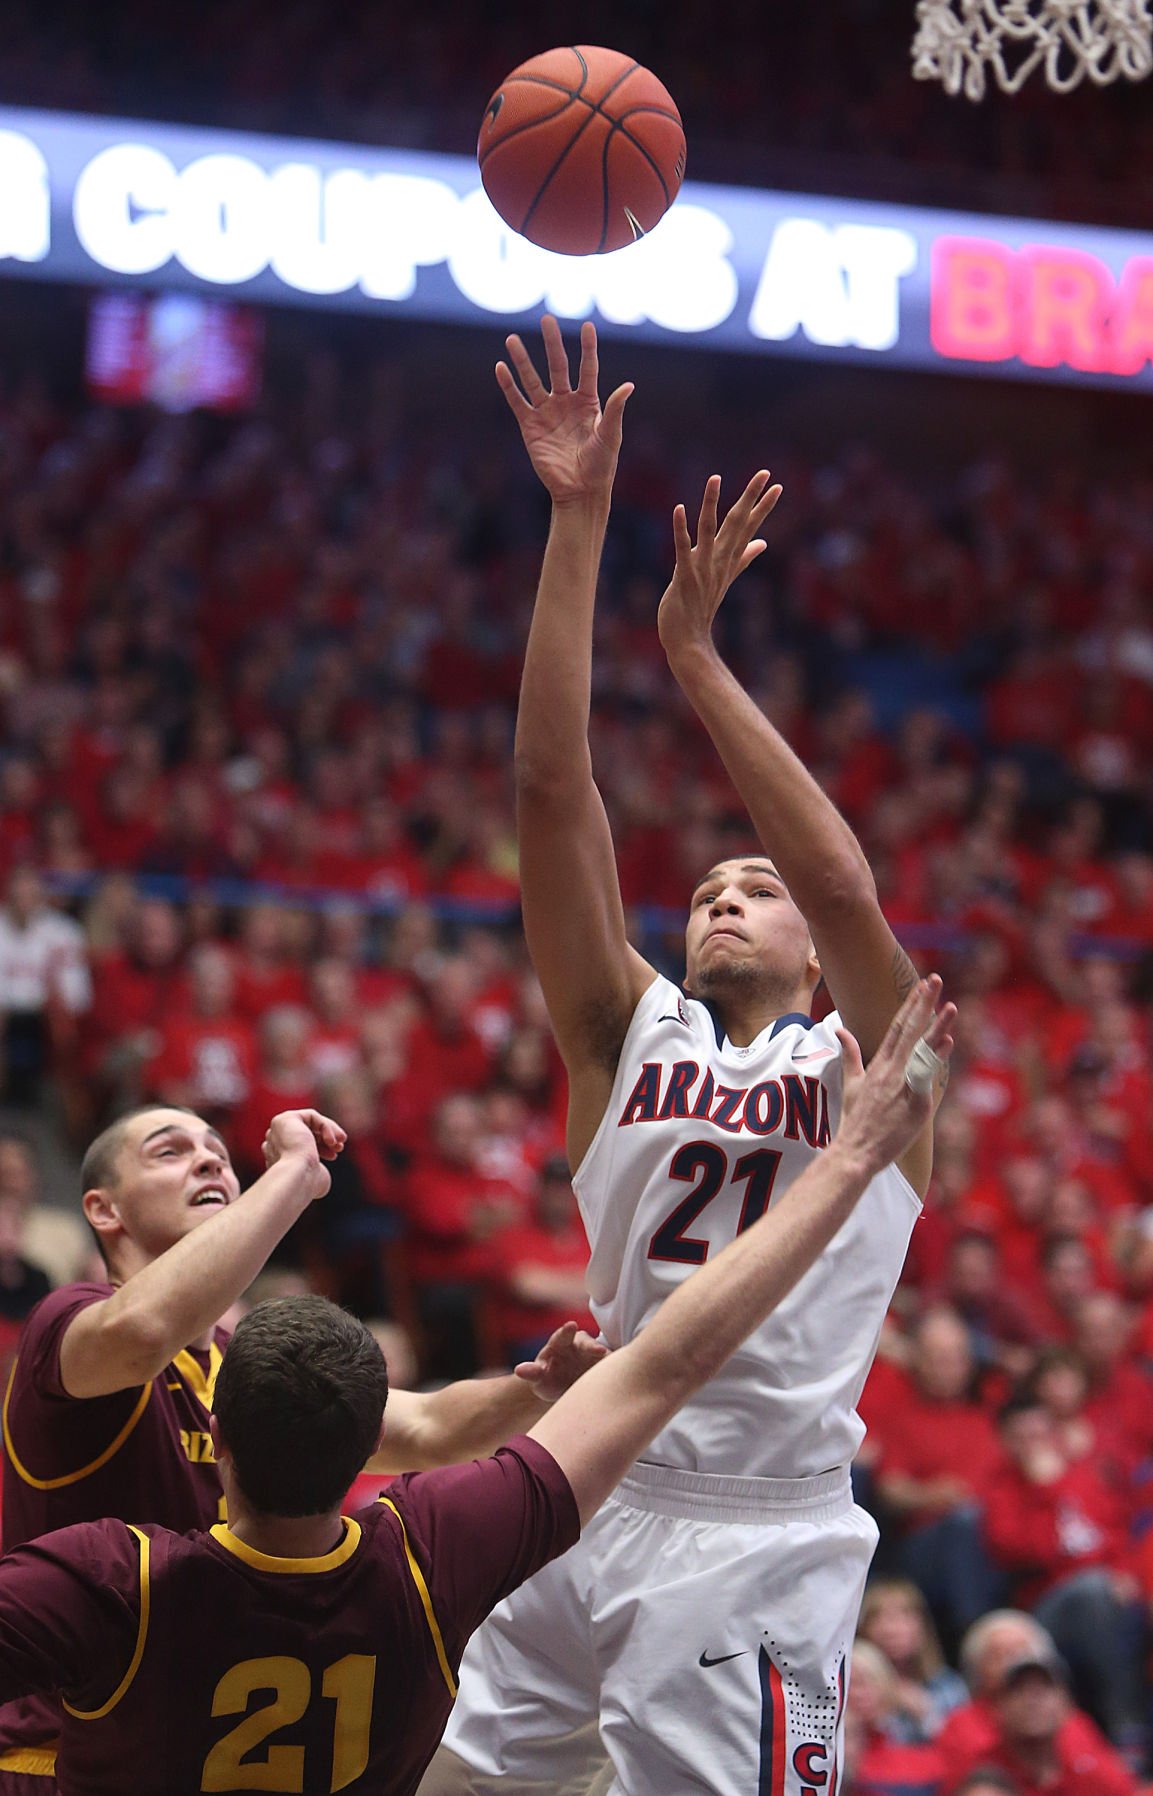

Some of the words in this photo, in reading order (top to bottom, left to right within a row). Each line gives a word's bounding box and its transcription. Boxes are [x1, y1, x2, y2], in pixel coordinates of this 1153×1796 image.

[748, 218, 917, 351] AT
[647, 1140, 783, 1265] 21
[200, 1653, 376, 1794] 21
